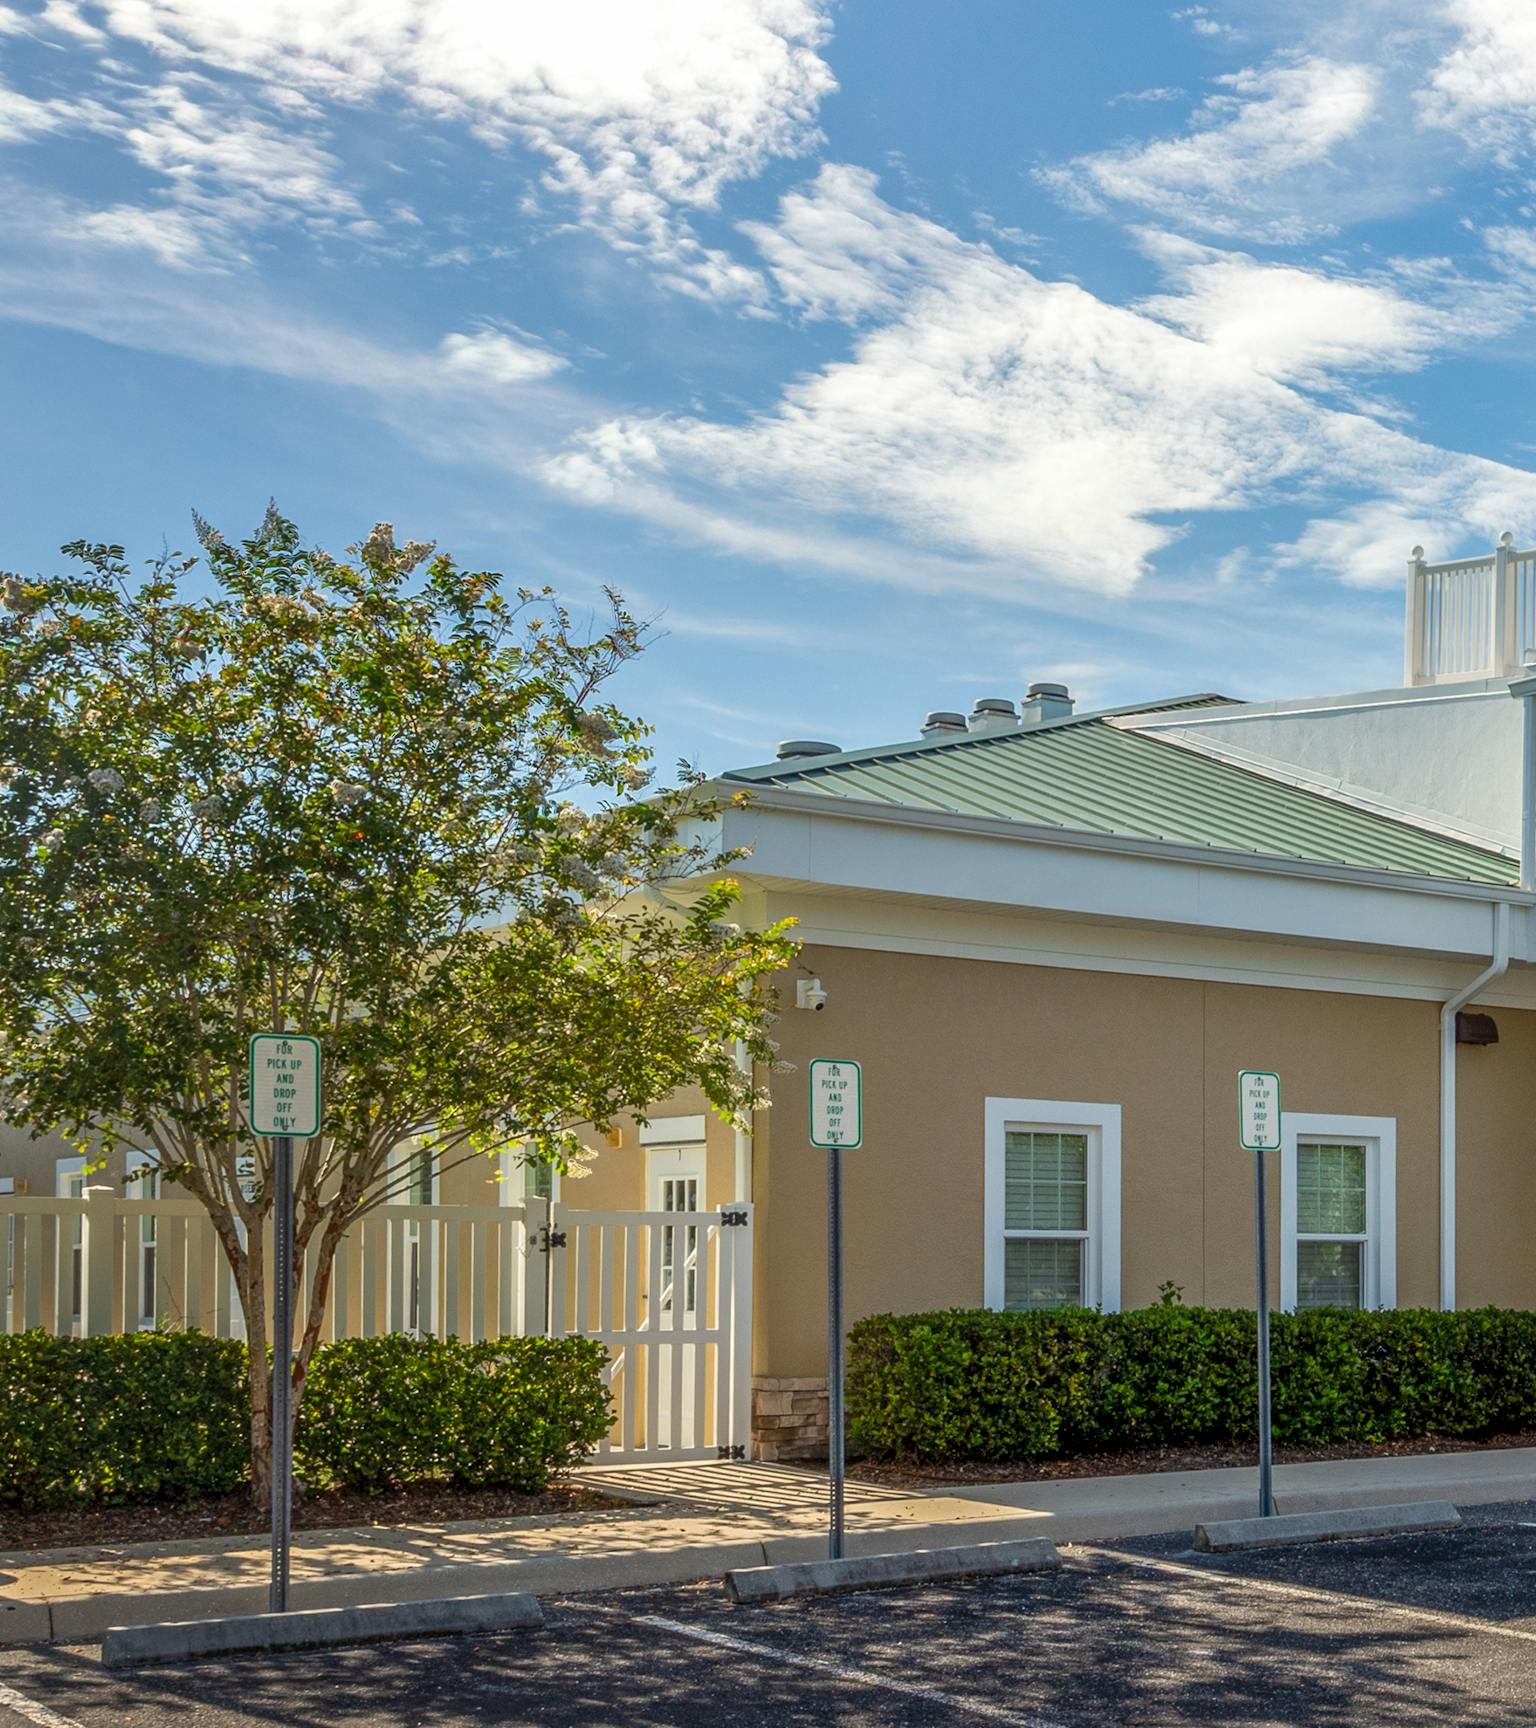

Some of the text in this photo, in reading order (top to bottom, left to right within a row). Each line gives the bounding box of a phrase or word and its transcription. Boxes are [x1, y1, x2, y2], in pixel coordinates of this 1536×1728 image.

[276, 1044, 293, 1055] FOR
[267, 1058, 302, 1069] PICK UP
[828, 1067, 841, 1077] FOR
[276, 1073, 295, 1084] AND
[821, 1079, 848, 1090] PICK UP
[273, 1088, 296, 1099] DROP
[828, 1093, 842, 1102] AND
[1249, 1089, 1261, 1098] PICK
[276, 1102, 293, 1113] OFF
[826, 1105, 844, 1115] DROP
[1255, 1101, 1266, 1110] AND
[1253, 1112, 1267, 1121] DROP
[273, 1117, 297, 1128] ONLY
[829, 1118, 841, 1127] OFF
[826, 1130, 844, 1140] ONLY
